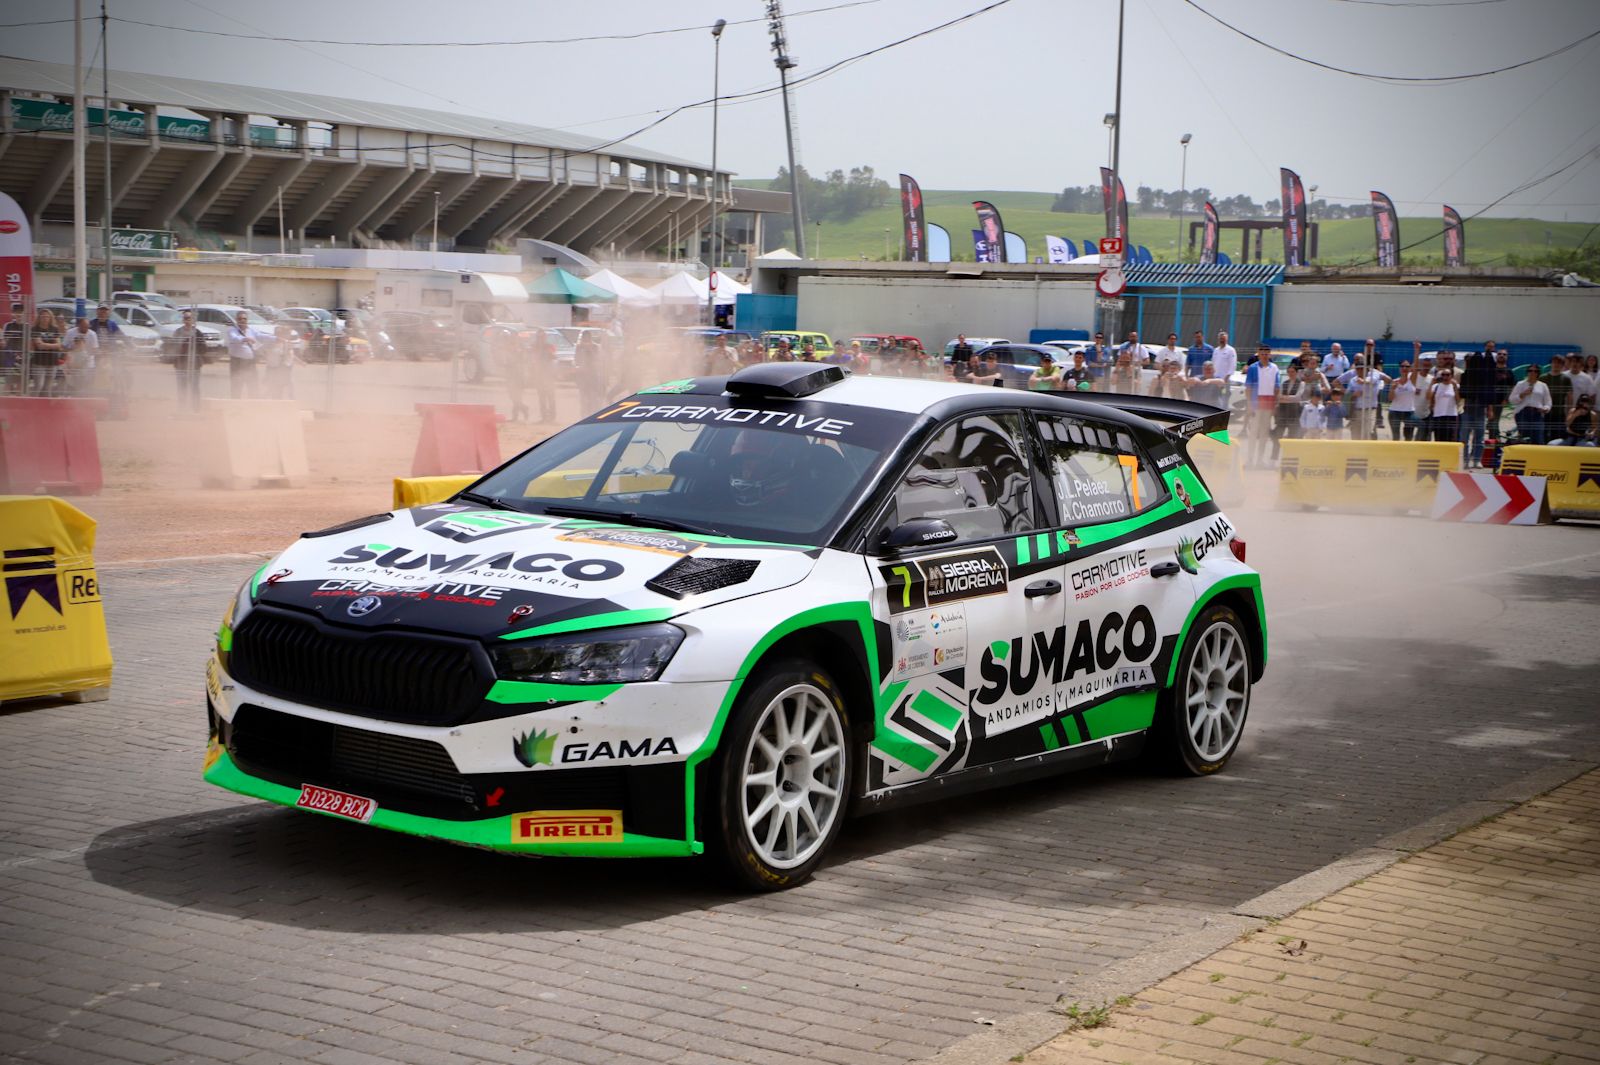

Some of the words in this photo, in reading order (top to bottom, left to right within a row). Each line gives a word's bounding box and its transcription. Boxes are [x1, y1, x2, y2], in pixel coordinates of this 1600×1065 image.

[598, 401, 641, 419] 7
[622, 405, 854, 436] CARMOTIVE
[1117, 454, 1142, 511] 7
[1062, 500, 1124, 522] A.Chamorro
[922, 530, 956, 541] SKODA
[1193, 516, 1232, 562] GAMA
[328, 544, 625, 582] SUMACO
[328, 565, 427, 582] ANDAMIOS
[941, 558, 993, 578] SIERRA
[1071, 549, 1148, 591] CARMOTIVE
[318, 578, 511, 601] CARMOTIVE
[891, 566, 912, 608] 7
[945, 570, 1005, 594] MORENA
[976, 604, 1157, 705] SUMACO
[988, 694, 1051, 725] ANDAMIOS
[1057, 690, 1063, 703] Y
[1069, 668, 1148, 699] MAQUINARIA
[561, 737, 679, 763] GAMA
[300, 787, 311, 805] S
[309, 790, 342, 811] 0328
[520, 816, 613, 837] PIRELLI
